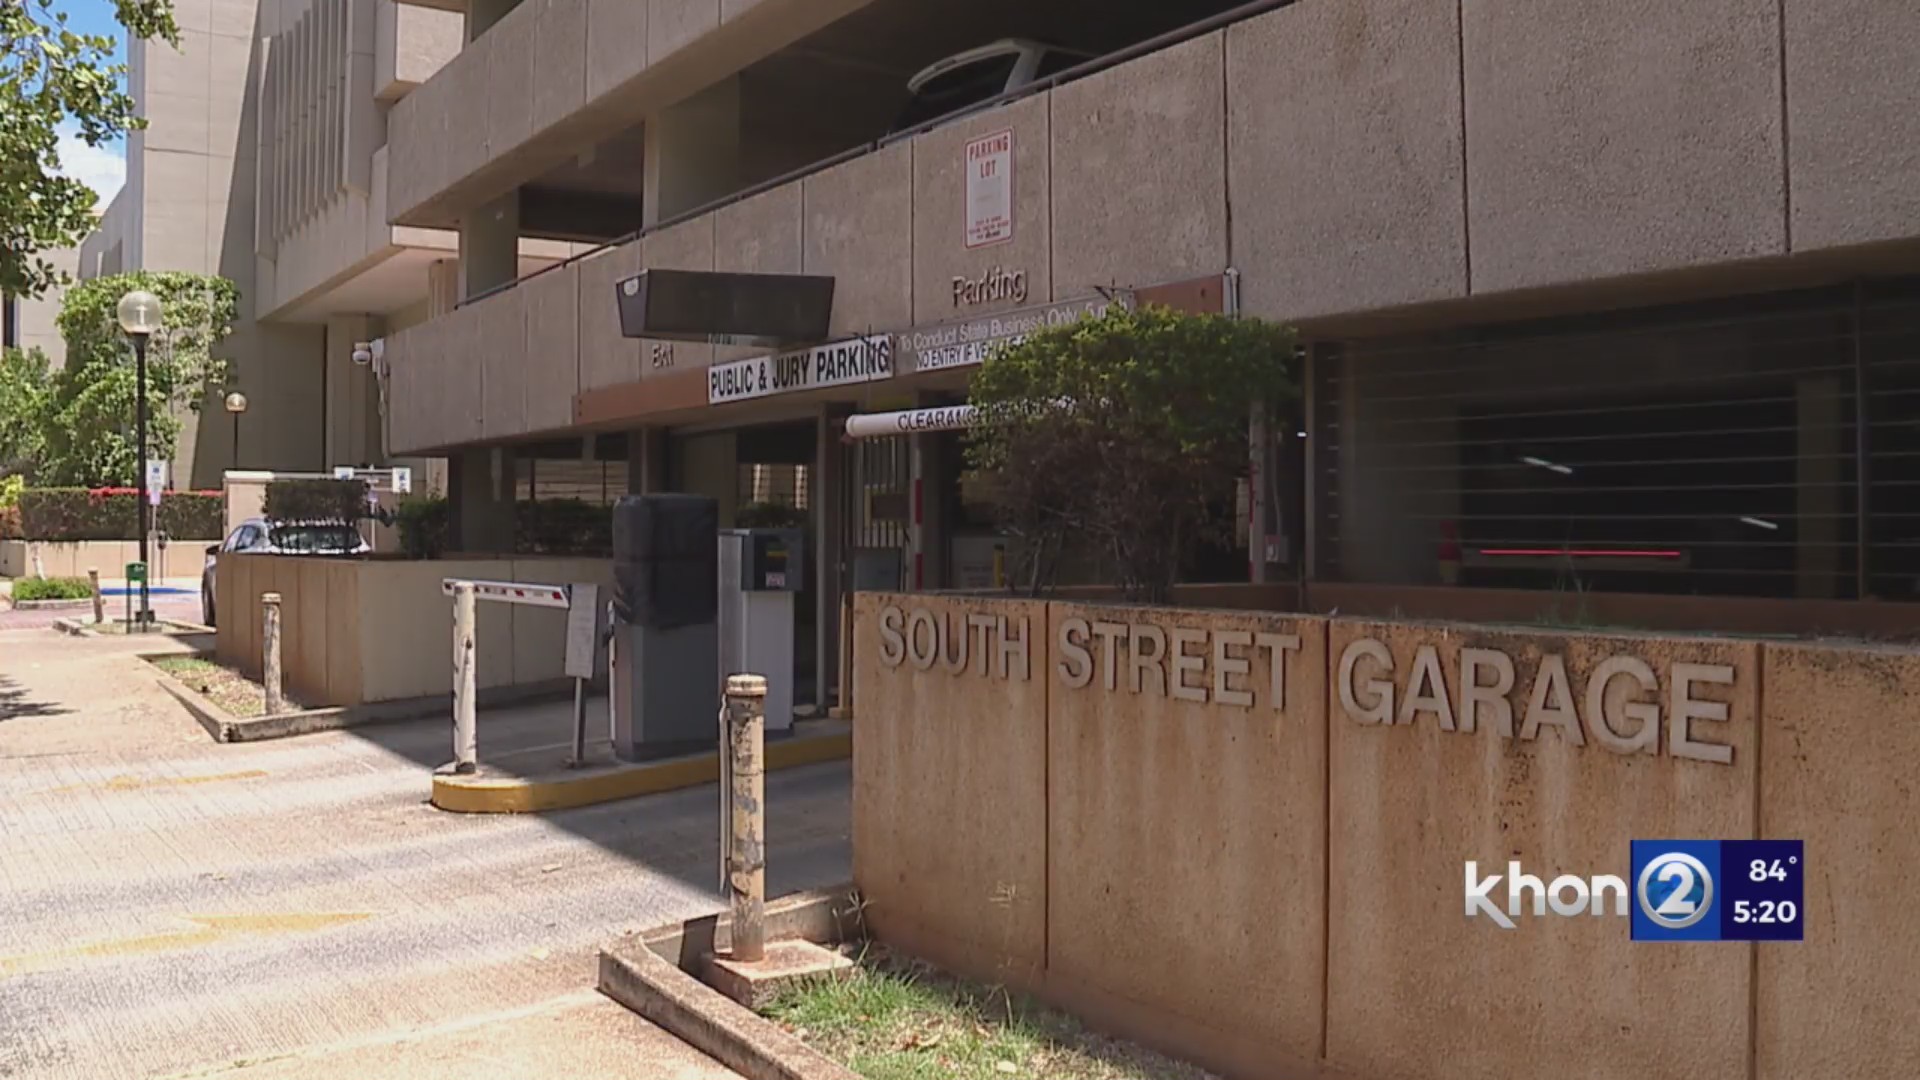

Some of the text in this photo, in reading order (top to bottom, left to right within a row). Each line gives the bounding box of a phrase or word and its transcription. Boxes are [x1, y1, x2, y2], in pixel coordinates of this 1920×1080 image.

[969, 135, 1009, 161] PARKING
[980, 159, 997, 179] LOT
[952, 266, 1028, 308] Parking
[900, 334, 912, 351] To
[913, 324, 956, 350] Conduct
[959, 317, 987, 343] State
[990, 309, 1044, 337] Business
[1048, 303, 1078, 328] Only
[710, 339, 891, 399] PUBLIC & JURY PARKING
[915, 344, 931, 370] NO
[931, 341, 962, 367] ENTRY
[963, 340, 973, 362] IF
[877, 604, 1736, 767] SOUTH STREET GARAGE
